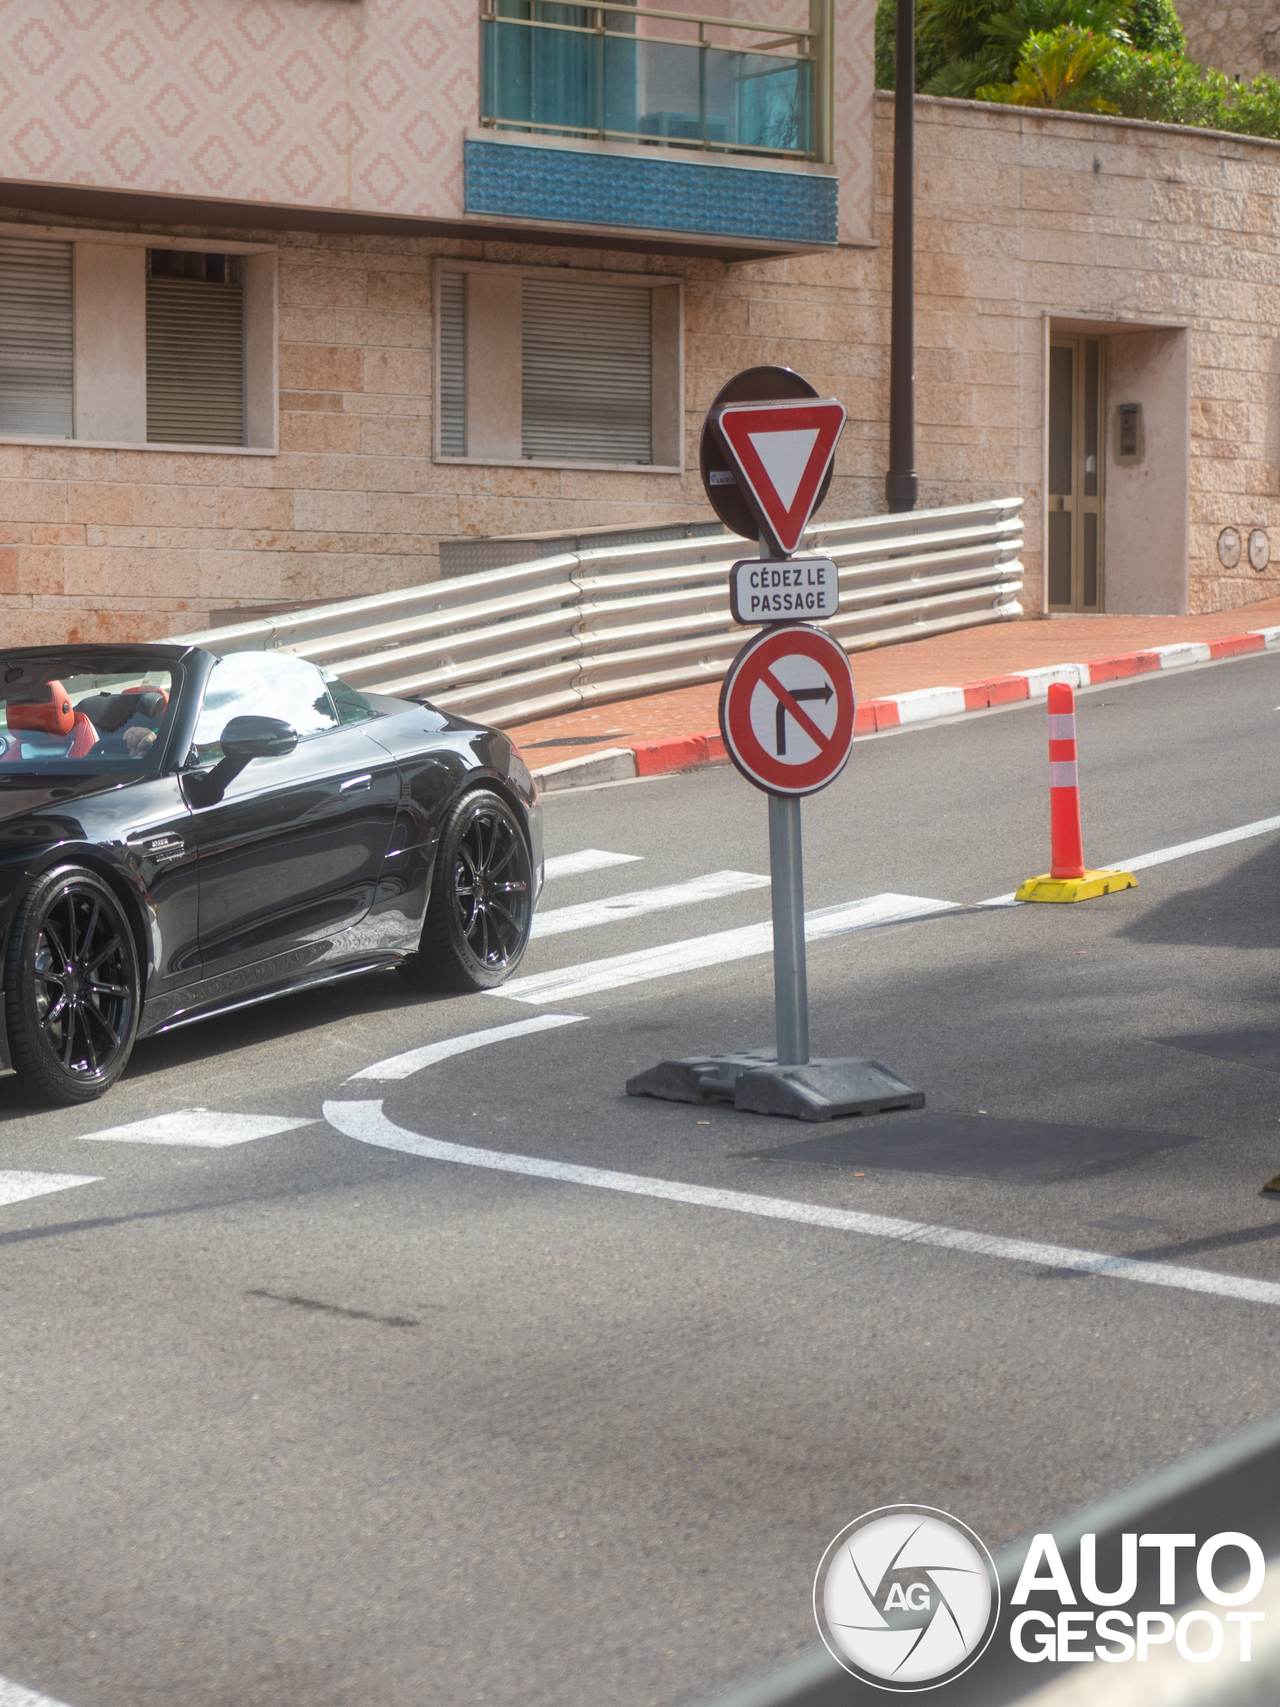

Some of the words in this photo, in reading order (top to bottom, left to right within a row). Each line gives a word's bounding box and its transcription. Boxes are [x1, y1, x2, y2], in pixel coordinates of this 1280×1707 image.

[750, 567, 802, 588] CÉDEZ
[808, 568, 825, 586] LE
[751, 592, 825, 612] PASSAGE
